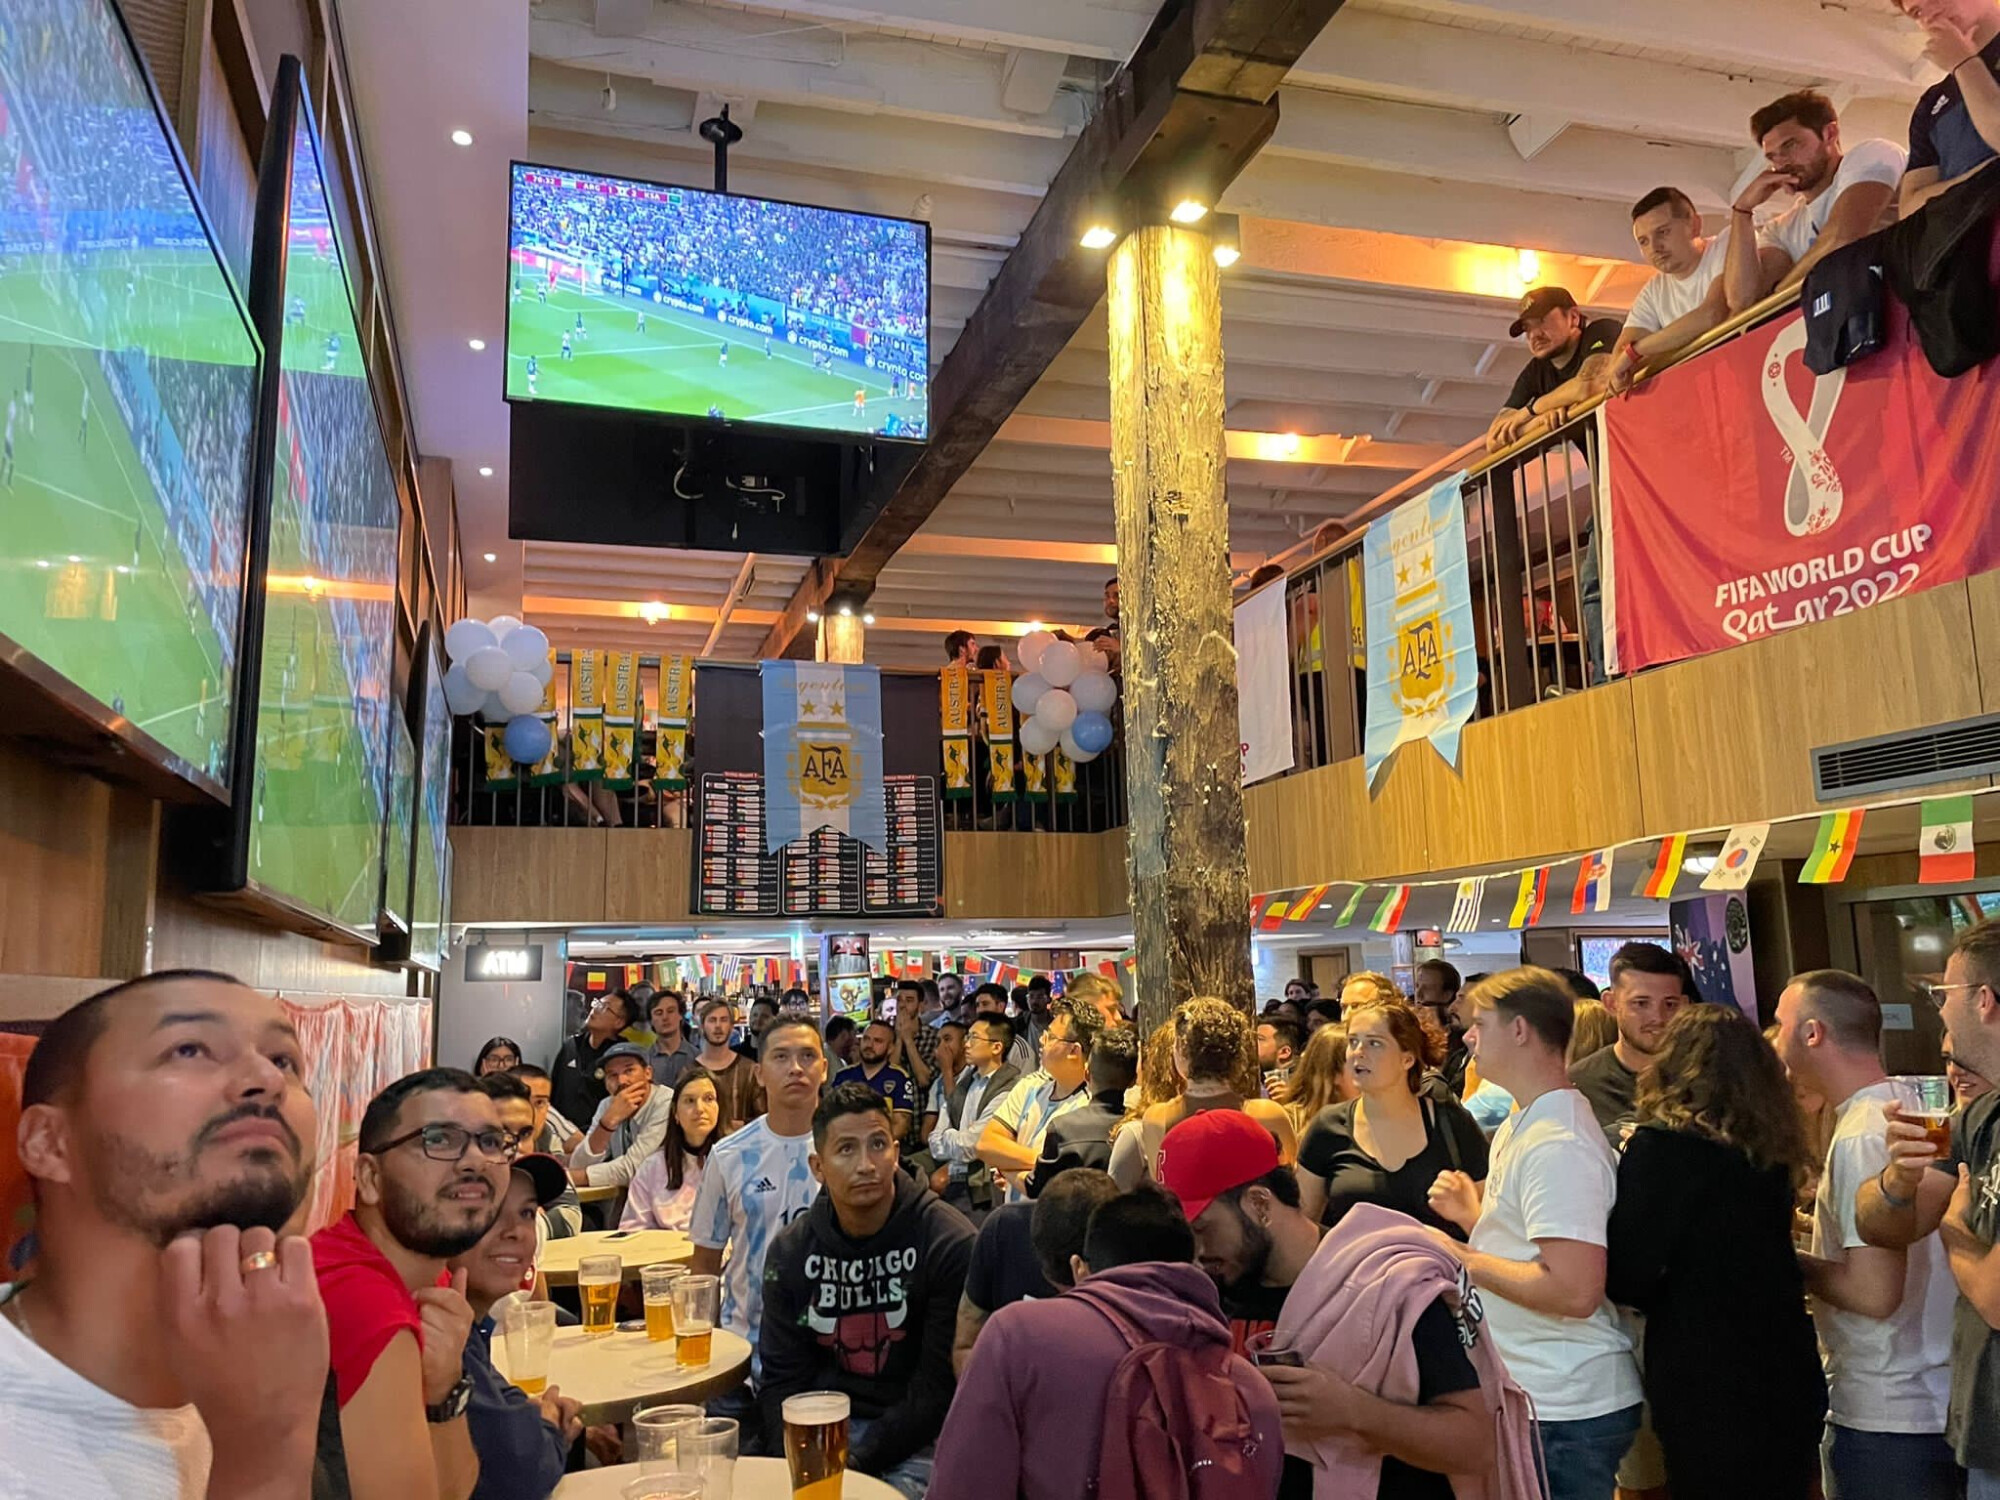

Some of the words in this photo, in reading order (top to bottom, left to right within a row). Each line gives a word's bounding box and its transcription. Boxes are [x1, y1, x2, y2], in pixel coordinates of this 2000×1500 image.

[583, 183, 600, 192] ARG
[663, 295, 705, 314] crypto.com
[728, 314, 773, 335] crypto.com
[798, 335, 849, 359] crypto.com
[1714, 578, 1765, 608] FIFA
[1763, 547, 1865, 595] WORLD
[1870, 523, 1932, 565] CUP
[1722, 597, 1829, 642] Qatar
[1828, 562, 1920, 618] 2022
[1402, 620, 1441, 680] AFA
[803, 744, 848, 785] AFA
[481, 950, 529, 975] ATM
[804, 1247, 917, 1283] CHICAGO
[818, 1277, 903, 1310] BULLS
